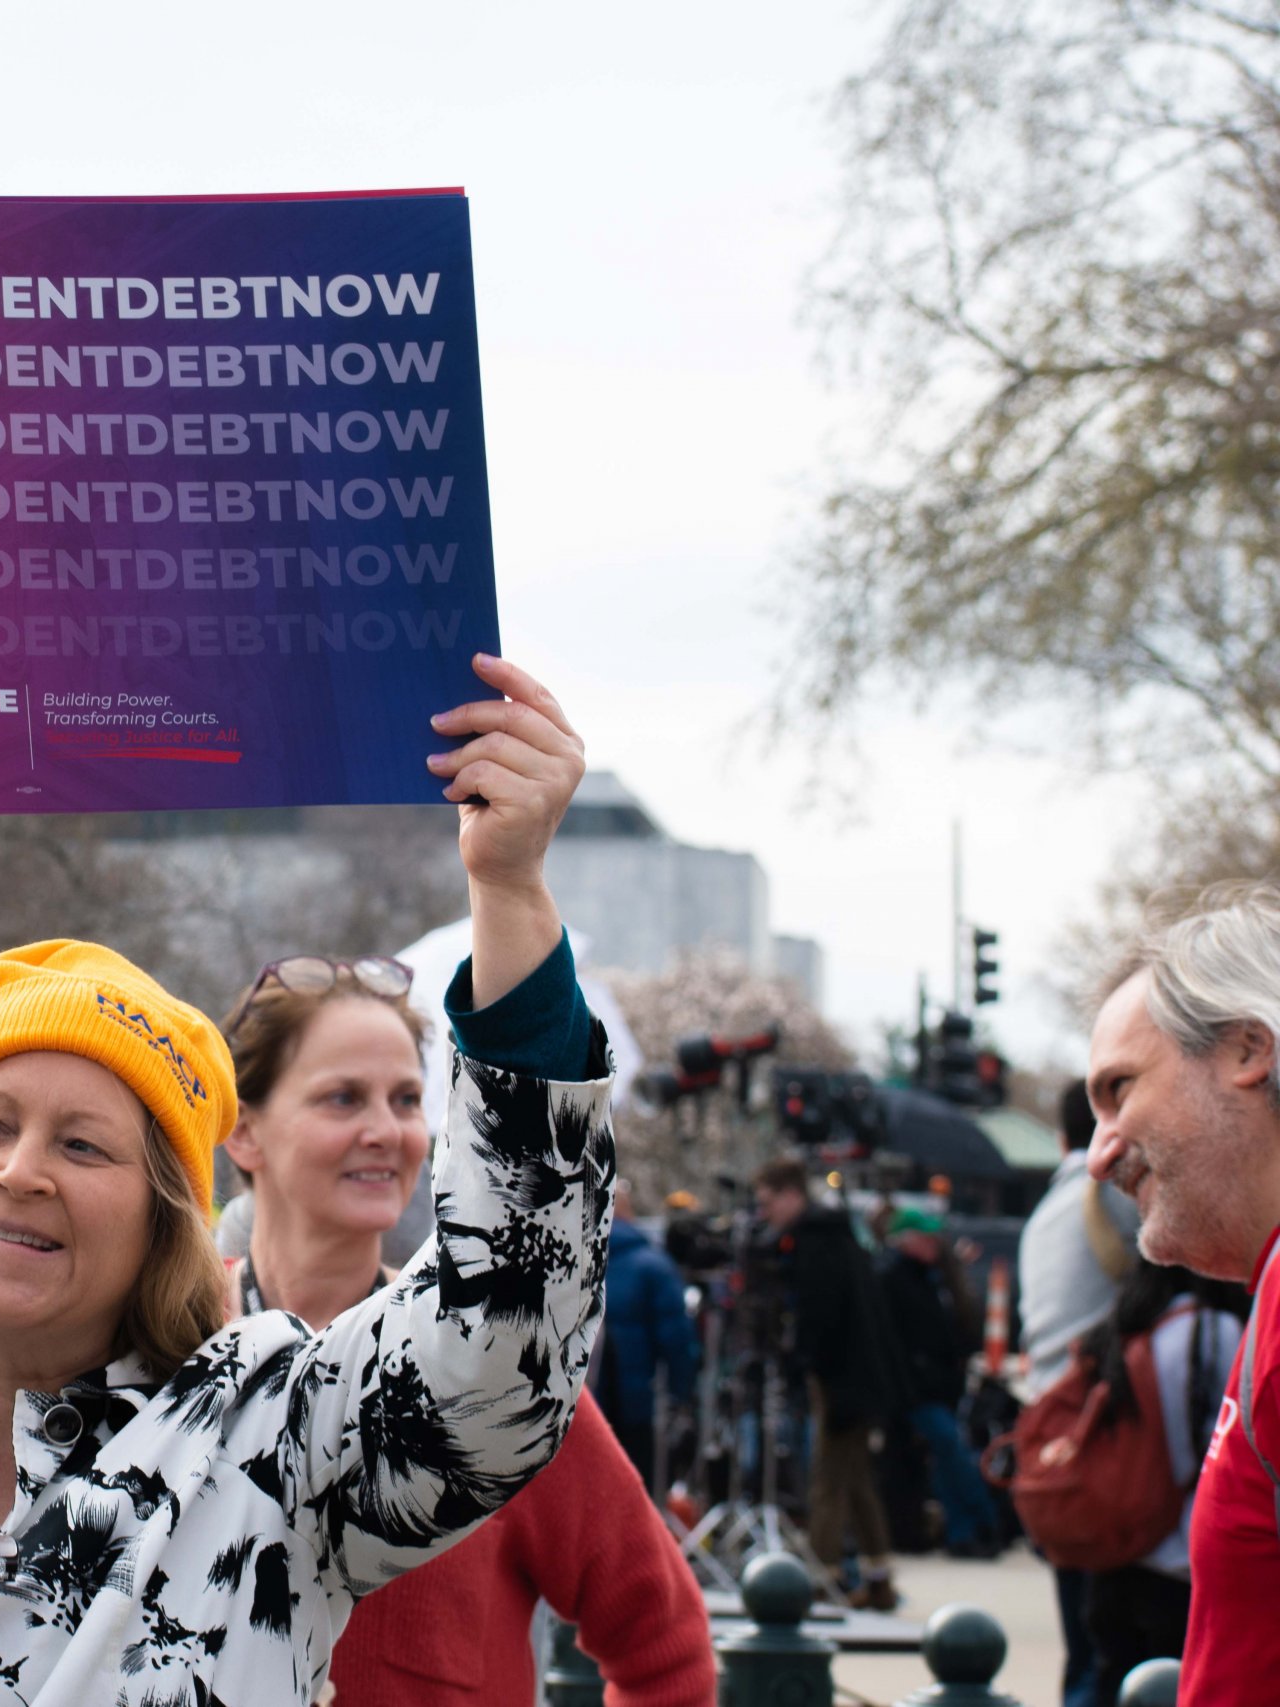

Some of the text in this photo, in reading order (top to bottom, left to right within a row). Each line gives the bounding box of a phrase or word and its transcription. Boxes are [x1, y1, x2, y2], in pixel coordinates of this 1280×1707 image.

[43, 692, 173, 709] Building Power.
[44, 711, 220, 728] Transforming Courts.
[124, 730, 184, 744] Justice
[187, 728, 212, 743] for
[214, 728, 241, 743] All.
